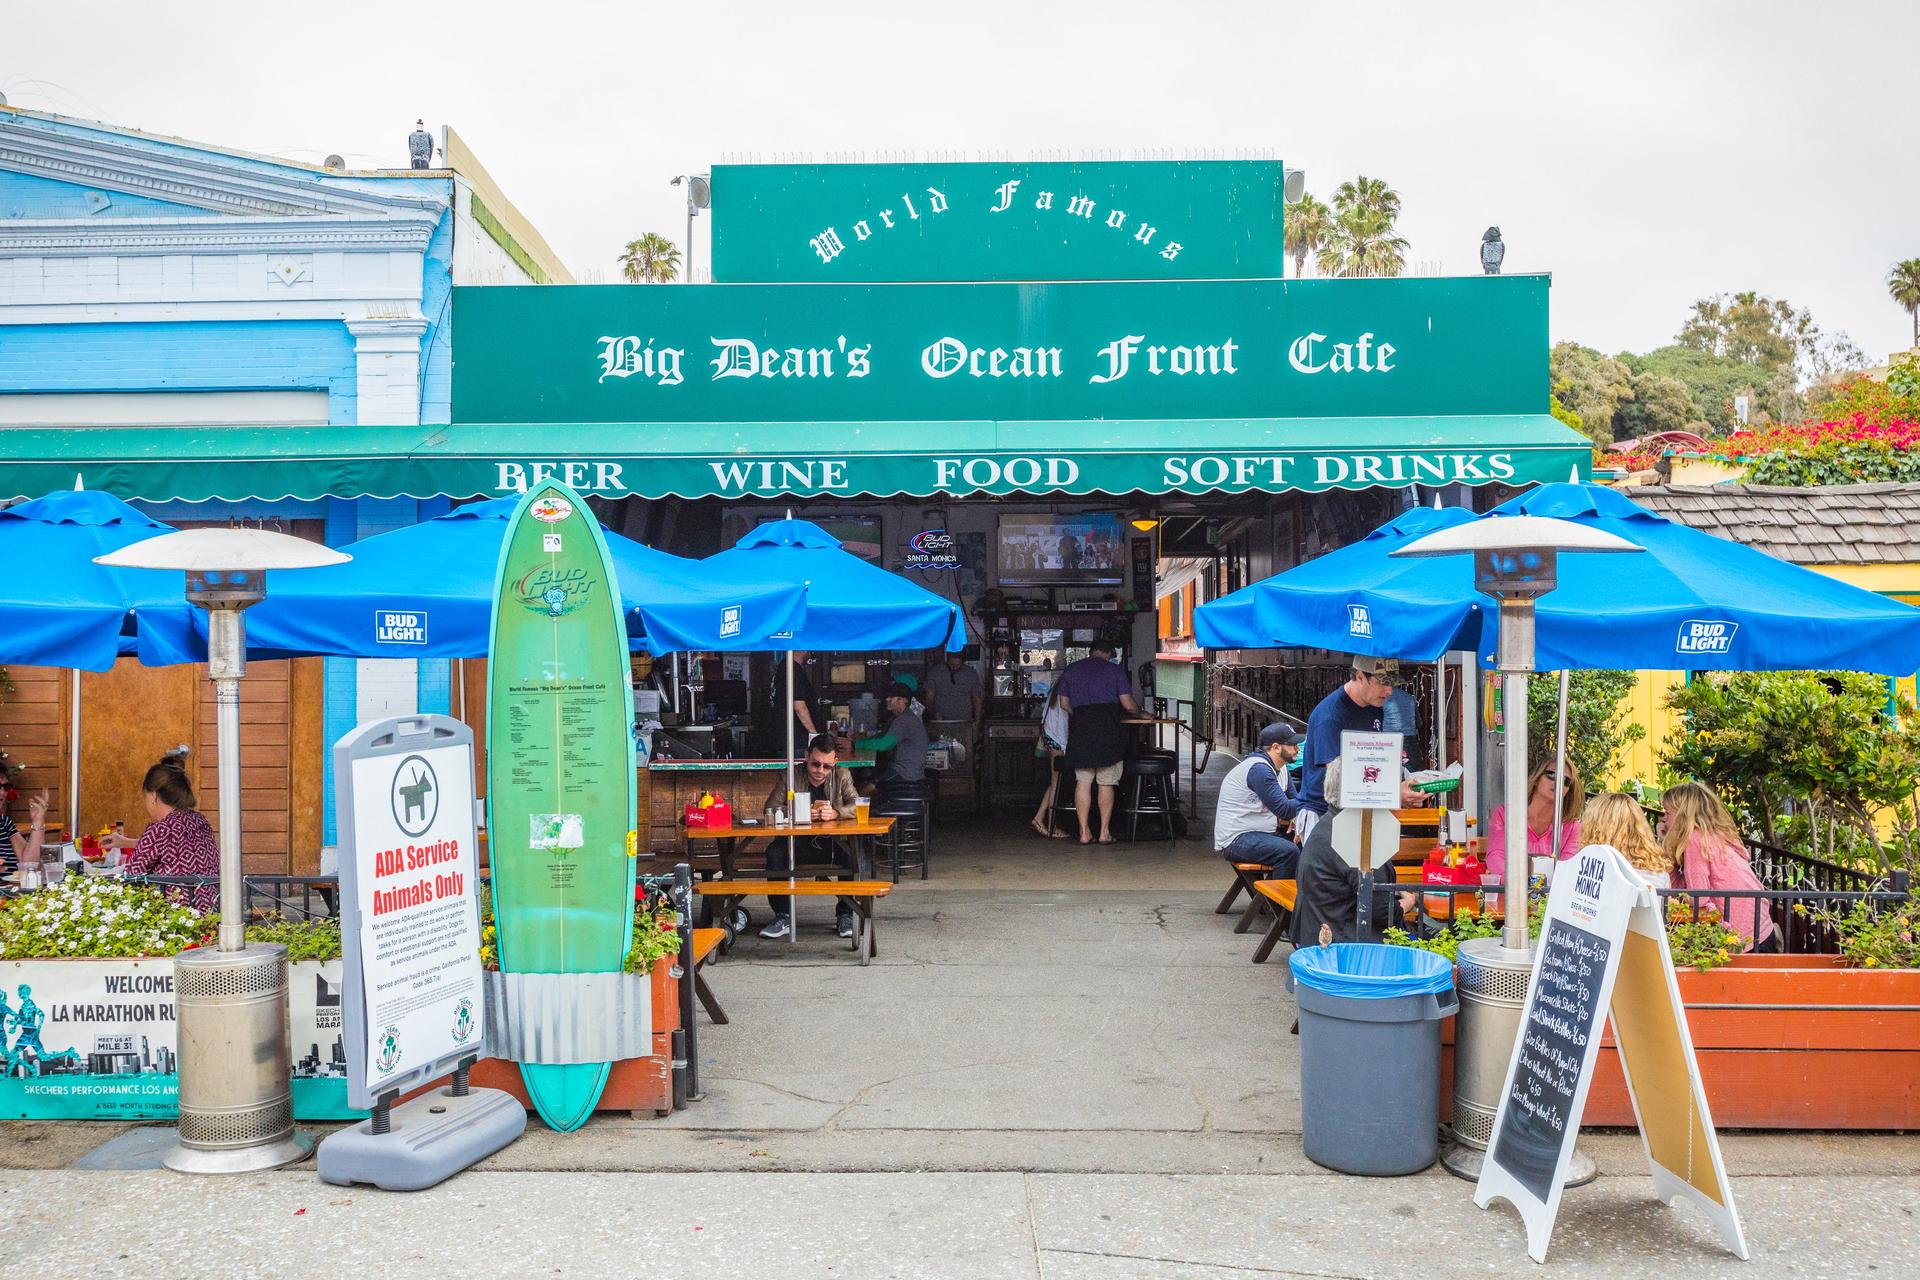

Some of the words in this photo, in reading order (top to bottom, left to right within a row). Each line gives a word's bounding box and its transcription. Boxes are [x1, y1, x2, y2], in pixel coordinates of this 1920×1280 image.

[809, 187, 949, 264] World
[989, 180, 1184, 261] Famous
[597, 336, 685, 385] Big
[710, 335, 871, 381] Dean's
[921, 336, 1064, 378] Ocean
[1089, 334, 1238, 383] Front
[1288, 332, 1396, 374] Cafe
[494, 462, 628, 490] BEER
[708, 460, 849, 490] WINE
[933, 458, 1080, 487] FOOD
[1163, 456, 1295, 486] SOFT
[1313, 453, 1515, 484] DRINKS
[931, 554, 957, 562] MONICA
[533, 568, 588, 585] BUD
[385, 614, 418, 627] BUD
[724, 610, 738, 622] BUD
[379, 627, 424, 640] LIGHT
[721, 621, 740, 635] LIGHT
[1690, 623, 1725, 637] BUD
[1680, 636, 1728, 650] LIGHT
[375, 848, 404, 877] ADA
[407, 840, 457, 869] Service
[1579, 856, 1605, 882] SANTA
[374, 880, 432, 914] Animals
[435, 872, 462, 898] Only
[1575, 876, 1601, 900] MONICA
[380, 919, 400, 928] welcome
[429, 906, 443, 915] service
[443, 902, 458, 910] animals
[1570, 901, 1582, 911] BREW
[1583, 906, 1597, 917] WORKS
[384, 926, 408, 937] individually
[409, 921, 423, 930] trained
[450, 909, 464, 918] perform
[376, 950, 393, 960] comfort
[399, 942, 420, 953] emotional
[421, 937, 437, 946] support
[378, 941, 391, 949] tasks
[402, 934, 416, 942] person
[396, 955, 411, 964] service
[412, 950, 428, 959] animals
[429, 946, 440, 954] under
[105, 975, 173, 994] WELCOME
[376, 981, 393, 991] Service
[394, 975, 408, 985] animal
[441, 959, 460, 969] California
[412, 981, 423, 989] Code
[52, 1004, 69, 1022] LA
[73, 1003, 156, 1022] MARATHON
[24, 1085, 69, 1096] SKECHERS
[71, 1085, 140, 1095] PERFORMANCE
[142, 1085, 160, 1094] LOS
